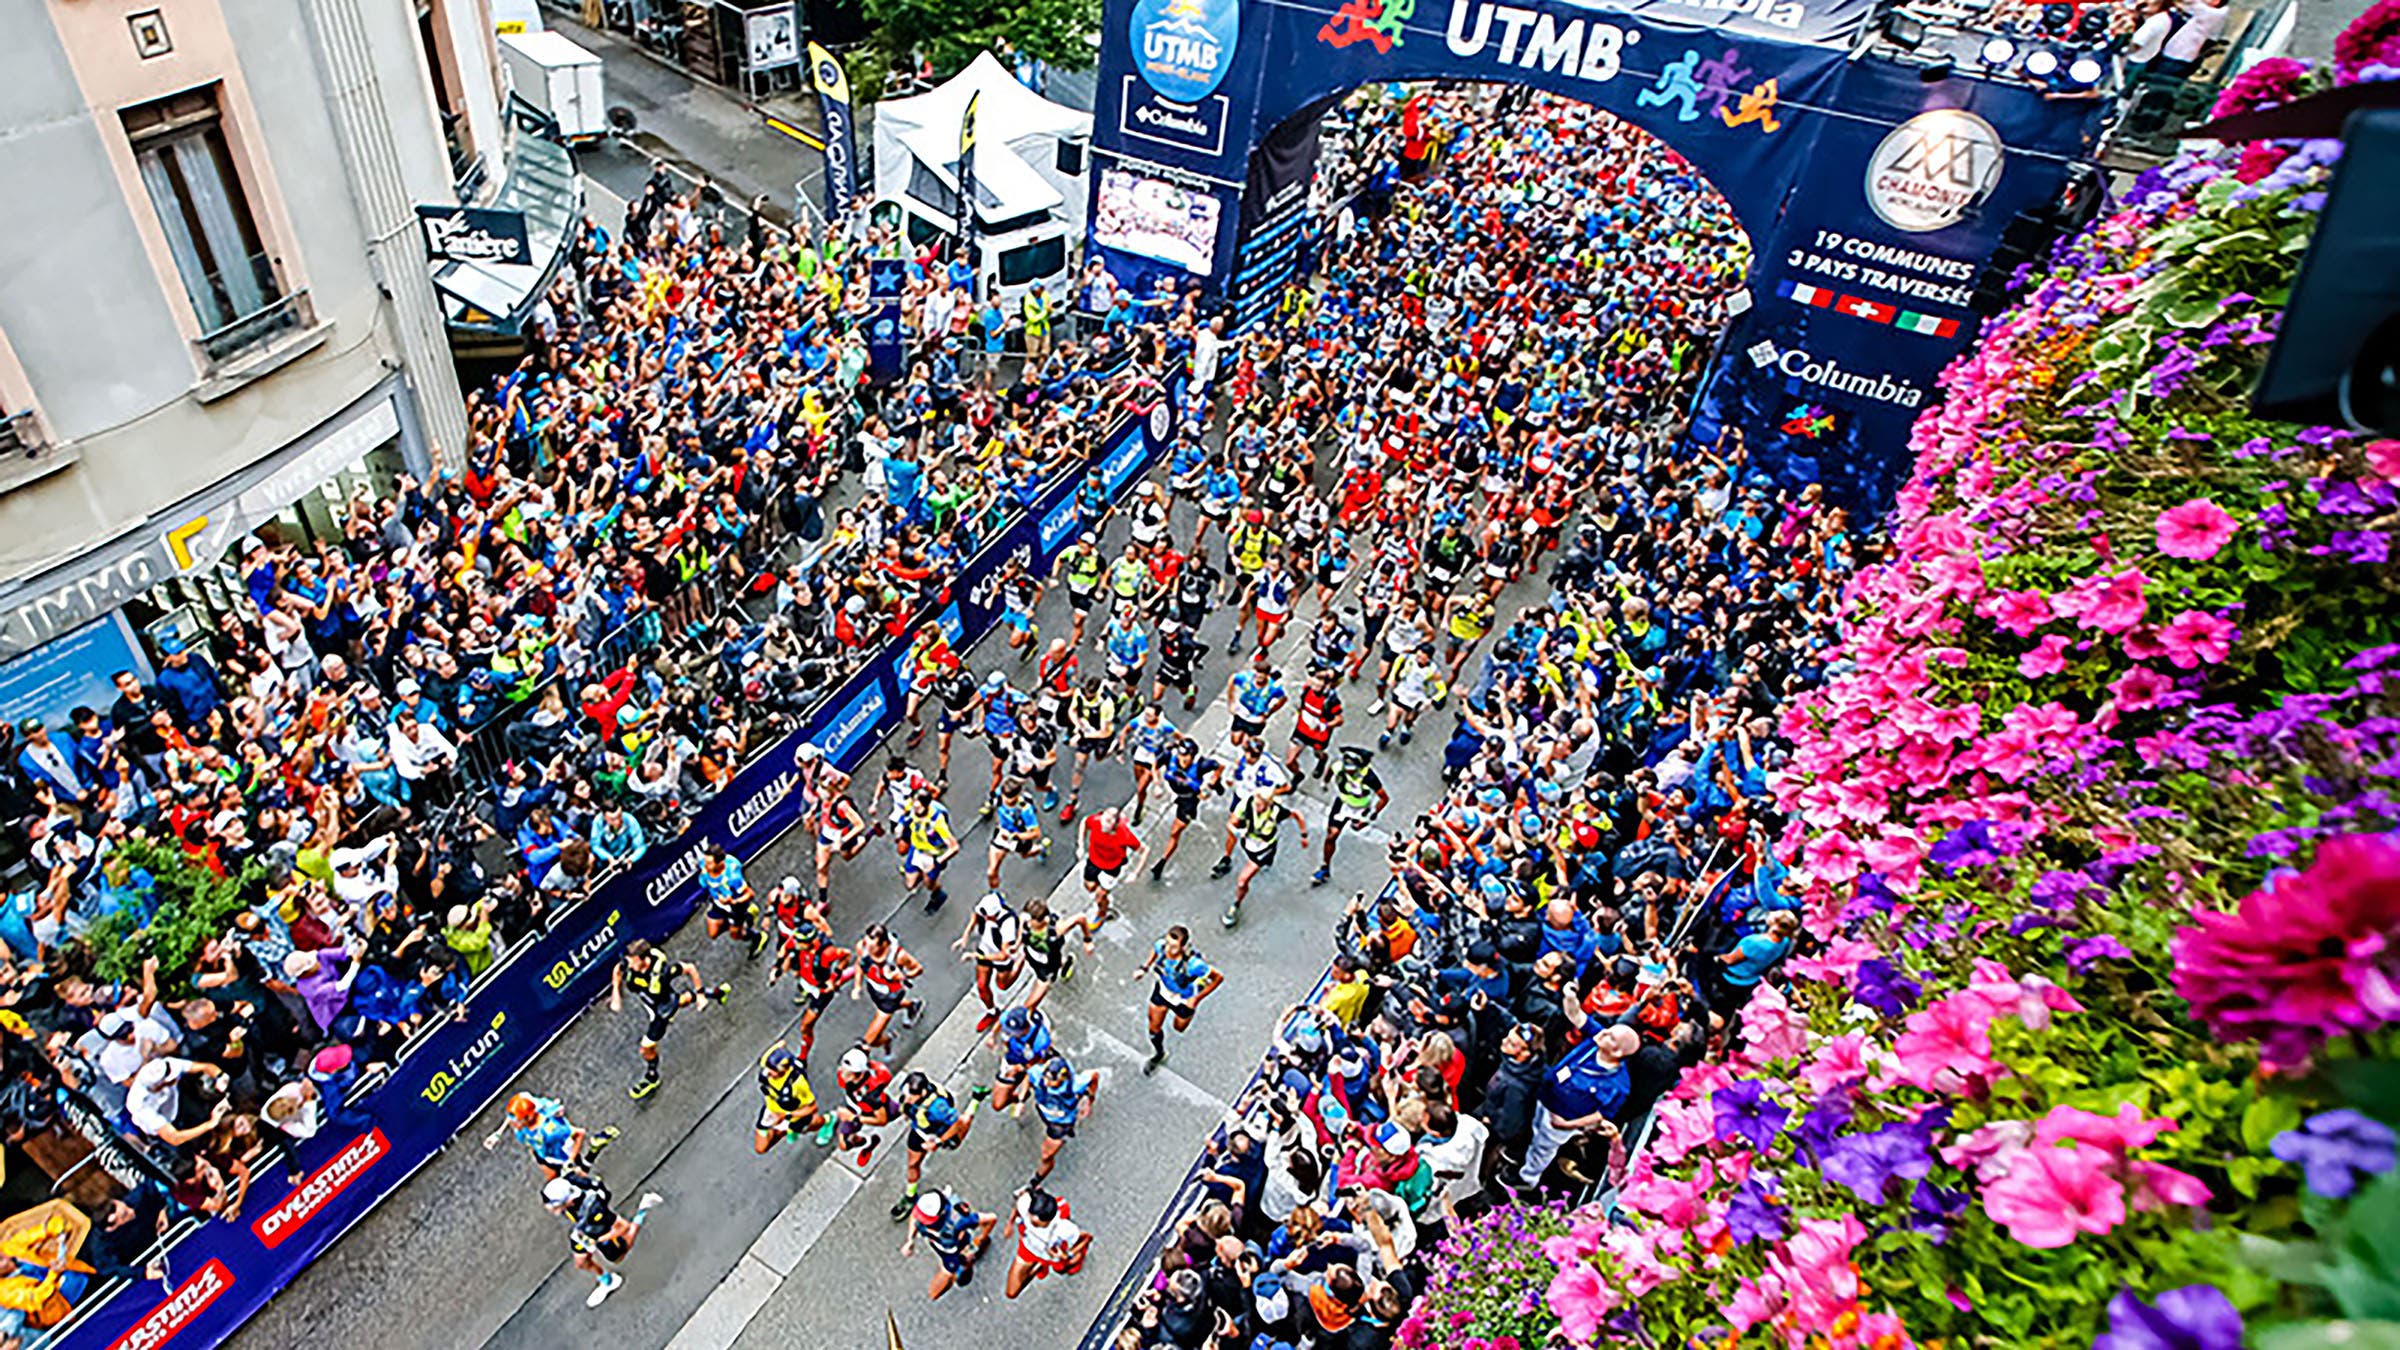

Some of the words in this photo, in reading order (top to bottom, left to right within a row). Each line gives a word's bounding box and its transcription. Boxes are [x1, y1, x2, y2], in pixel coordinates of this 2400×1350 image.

[1144, 31, 1218, 70] UTMB
[1787, 249, 1804, 267] 3
[1804, 254, 1859, 280] PAYS
[1814, 230, 1842, 250] 19
[1843, 238, 1975, 281] COMMUNES
[1779, 349, 1922, 408] Columbia
